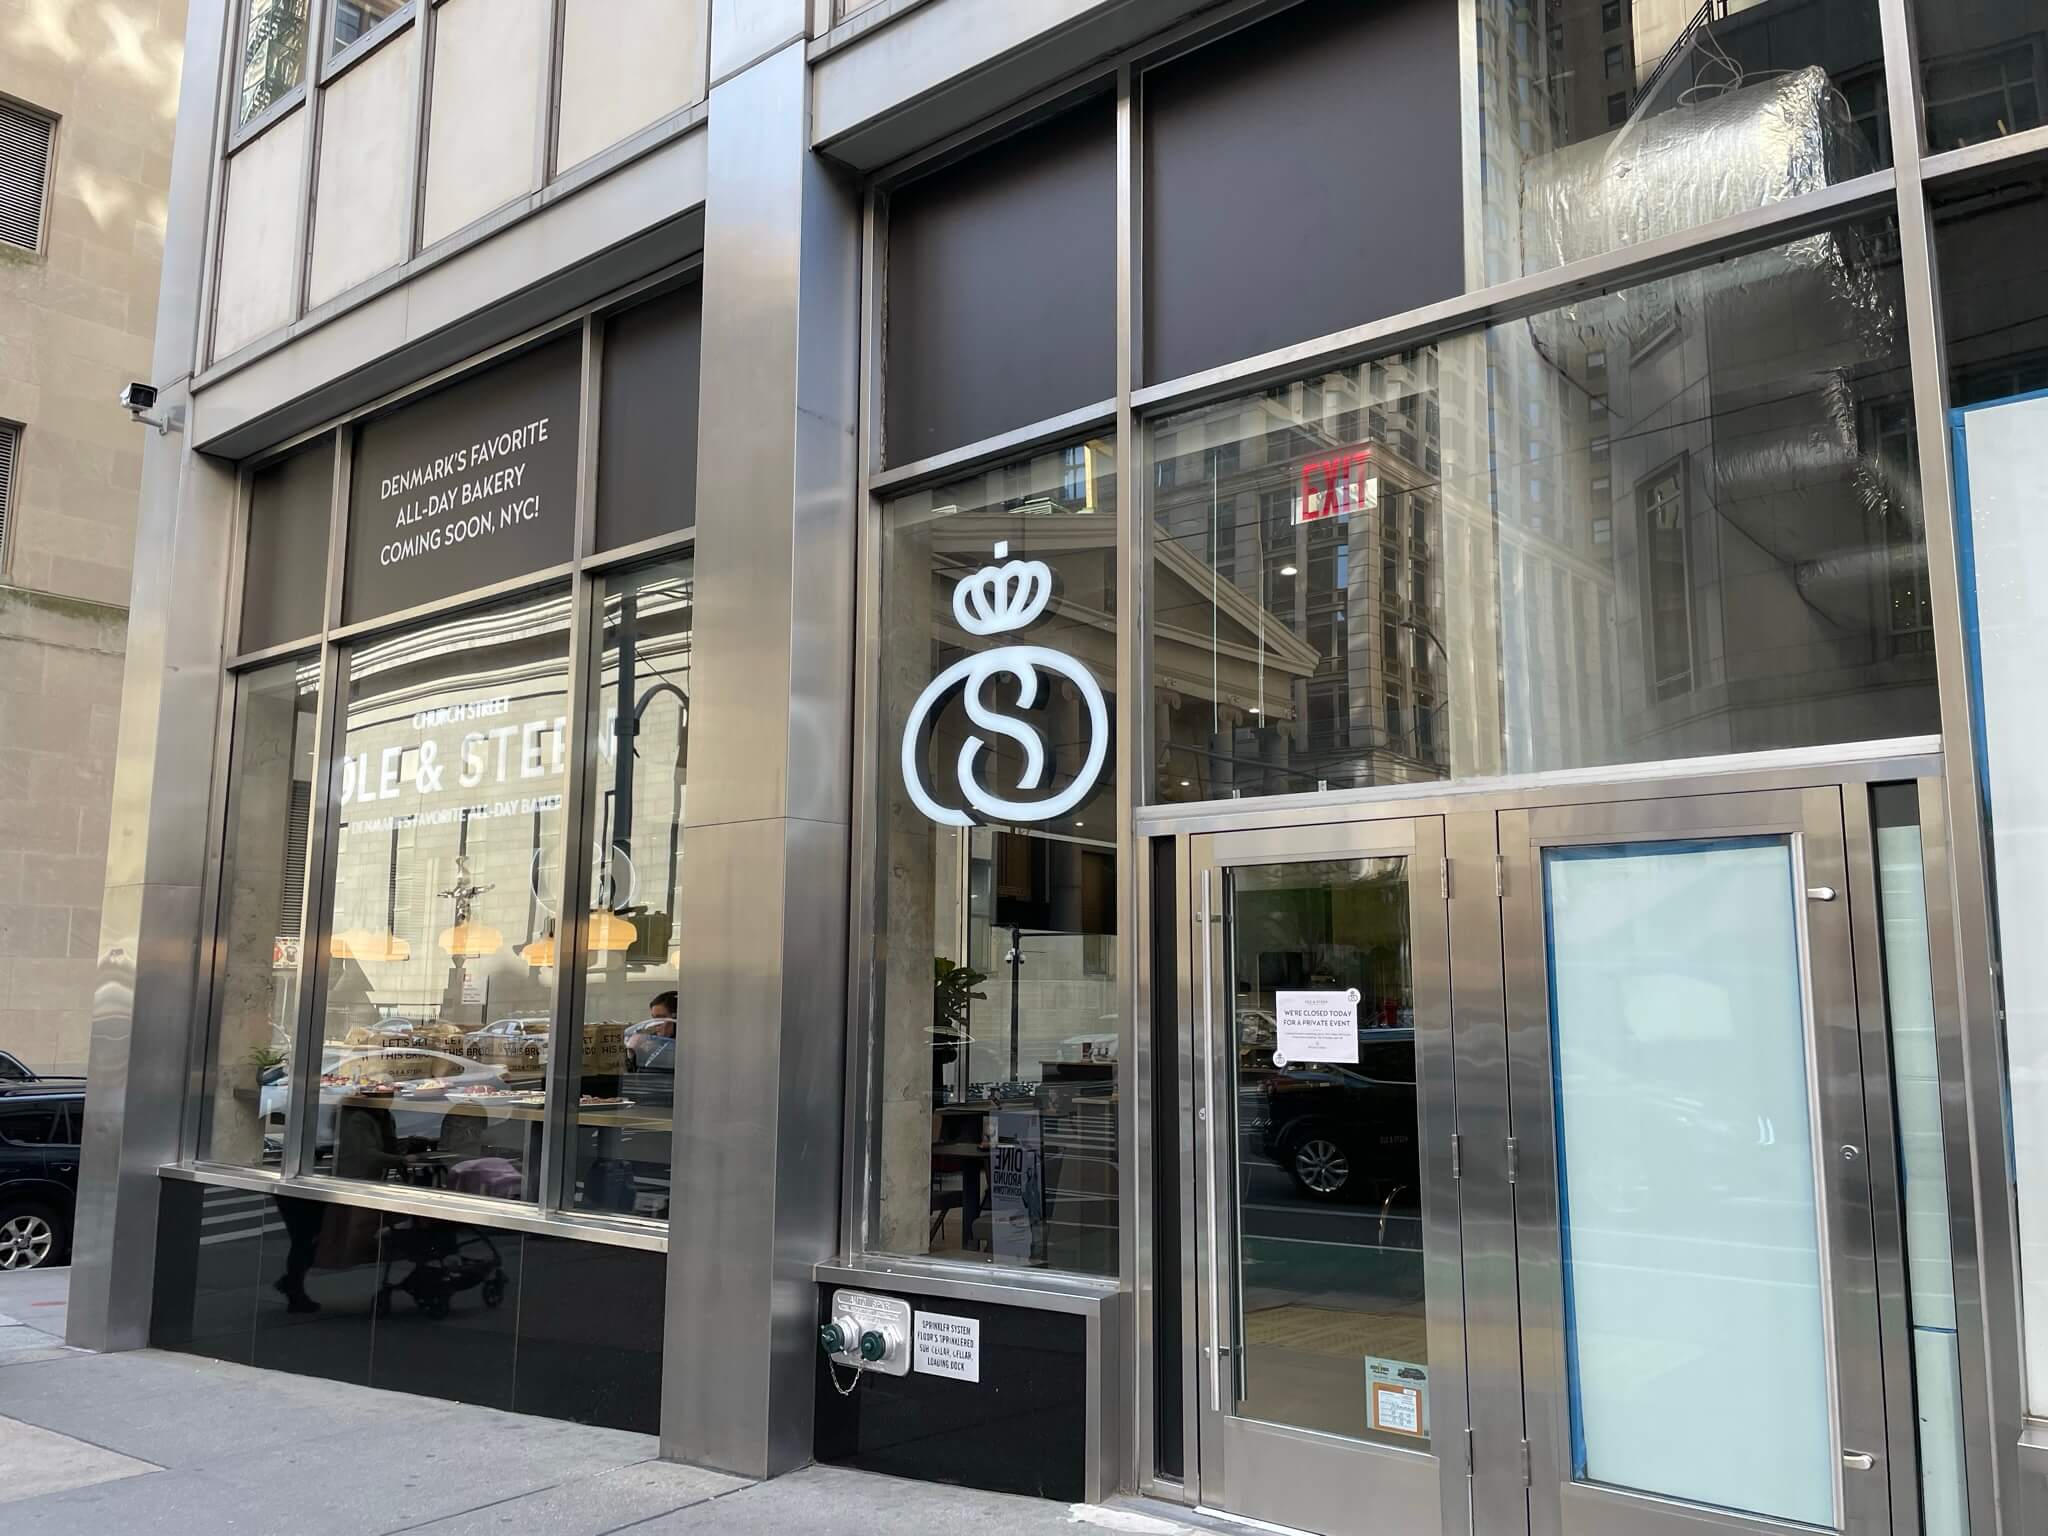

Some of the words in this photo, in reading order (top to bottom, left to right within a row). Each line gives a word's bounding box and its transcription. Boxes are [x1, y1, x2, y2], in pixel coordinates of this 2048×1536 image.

[381, 449, 467, 500] DENMARK'S
[471, 418, 549, 467] FAVORITE
[396, 487, 458, 528] ALL-DAY
[462, 463, 526, 505] BAKERY
[1302, 449, 1371, 520] EXIT
[381, 529, 441, 566] COMING
[445, 511, 495, 546] SOON,
[500, 495, 540, 529] NYC!
[412, 704, 465, 730] CHURCH
[467, 695, 512, 720] STREET
[416, 739, 444, 794] &
[1284, 1009, 1302, 1017] WE'RE
[922, 1320, 949, 1331] SPRINKLER
[951, 1324, 971, 1336] SYSTEM
[939, 1335, 974, 1348] SPRINKLERED
[919, 1343, 929, 1352] SUB
[927, 1357, 949, 1369] LOADING
[950, 1361, 965, 1372] DOCK
